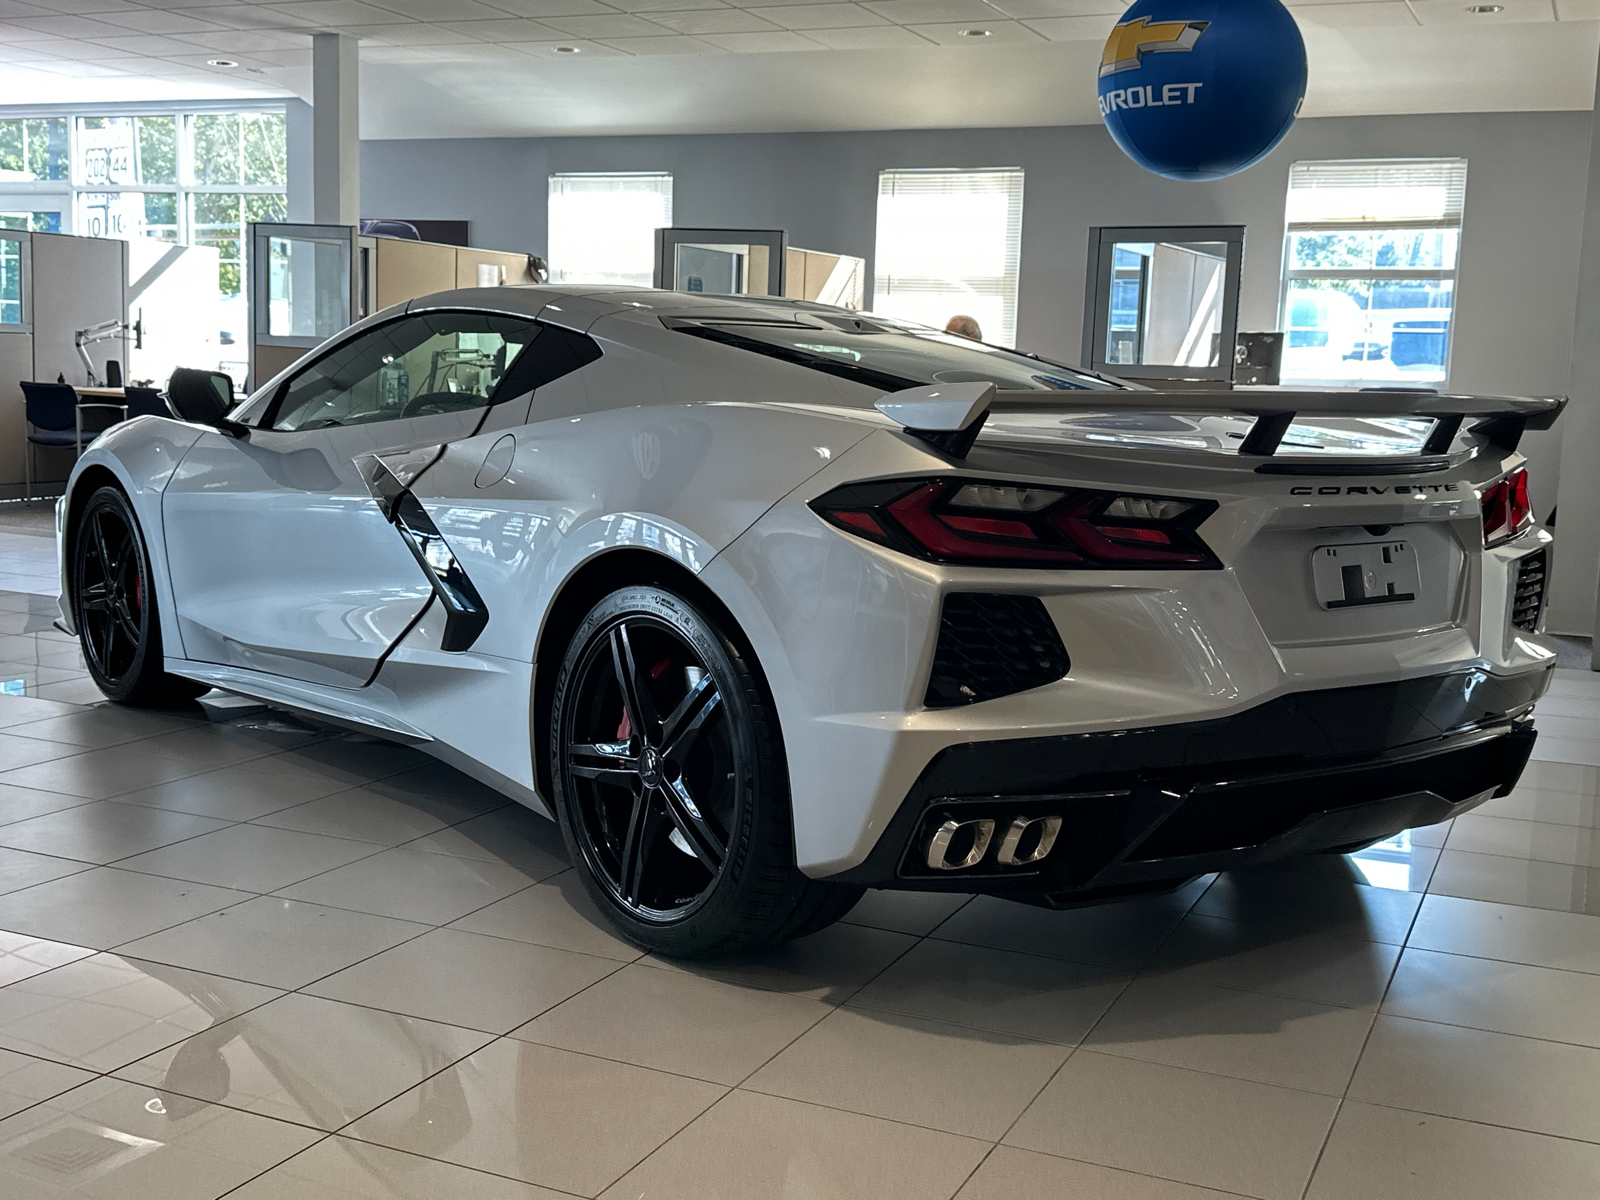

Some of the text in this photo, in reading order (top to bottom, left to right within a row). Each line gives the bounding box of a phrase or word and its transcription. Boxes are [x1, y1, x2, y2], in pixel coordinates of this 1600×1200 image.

[1098, 82, 1203, 117] EVROLET
[87, 157, 105, 178] 202
[112, 156, 127, 175] 44
[1290, 483, 1460, 496] CORVETTE
